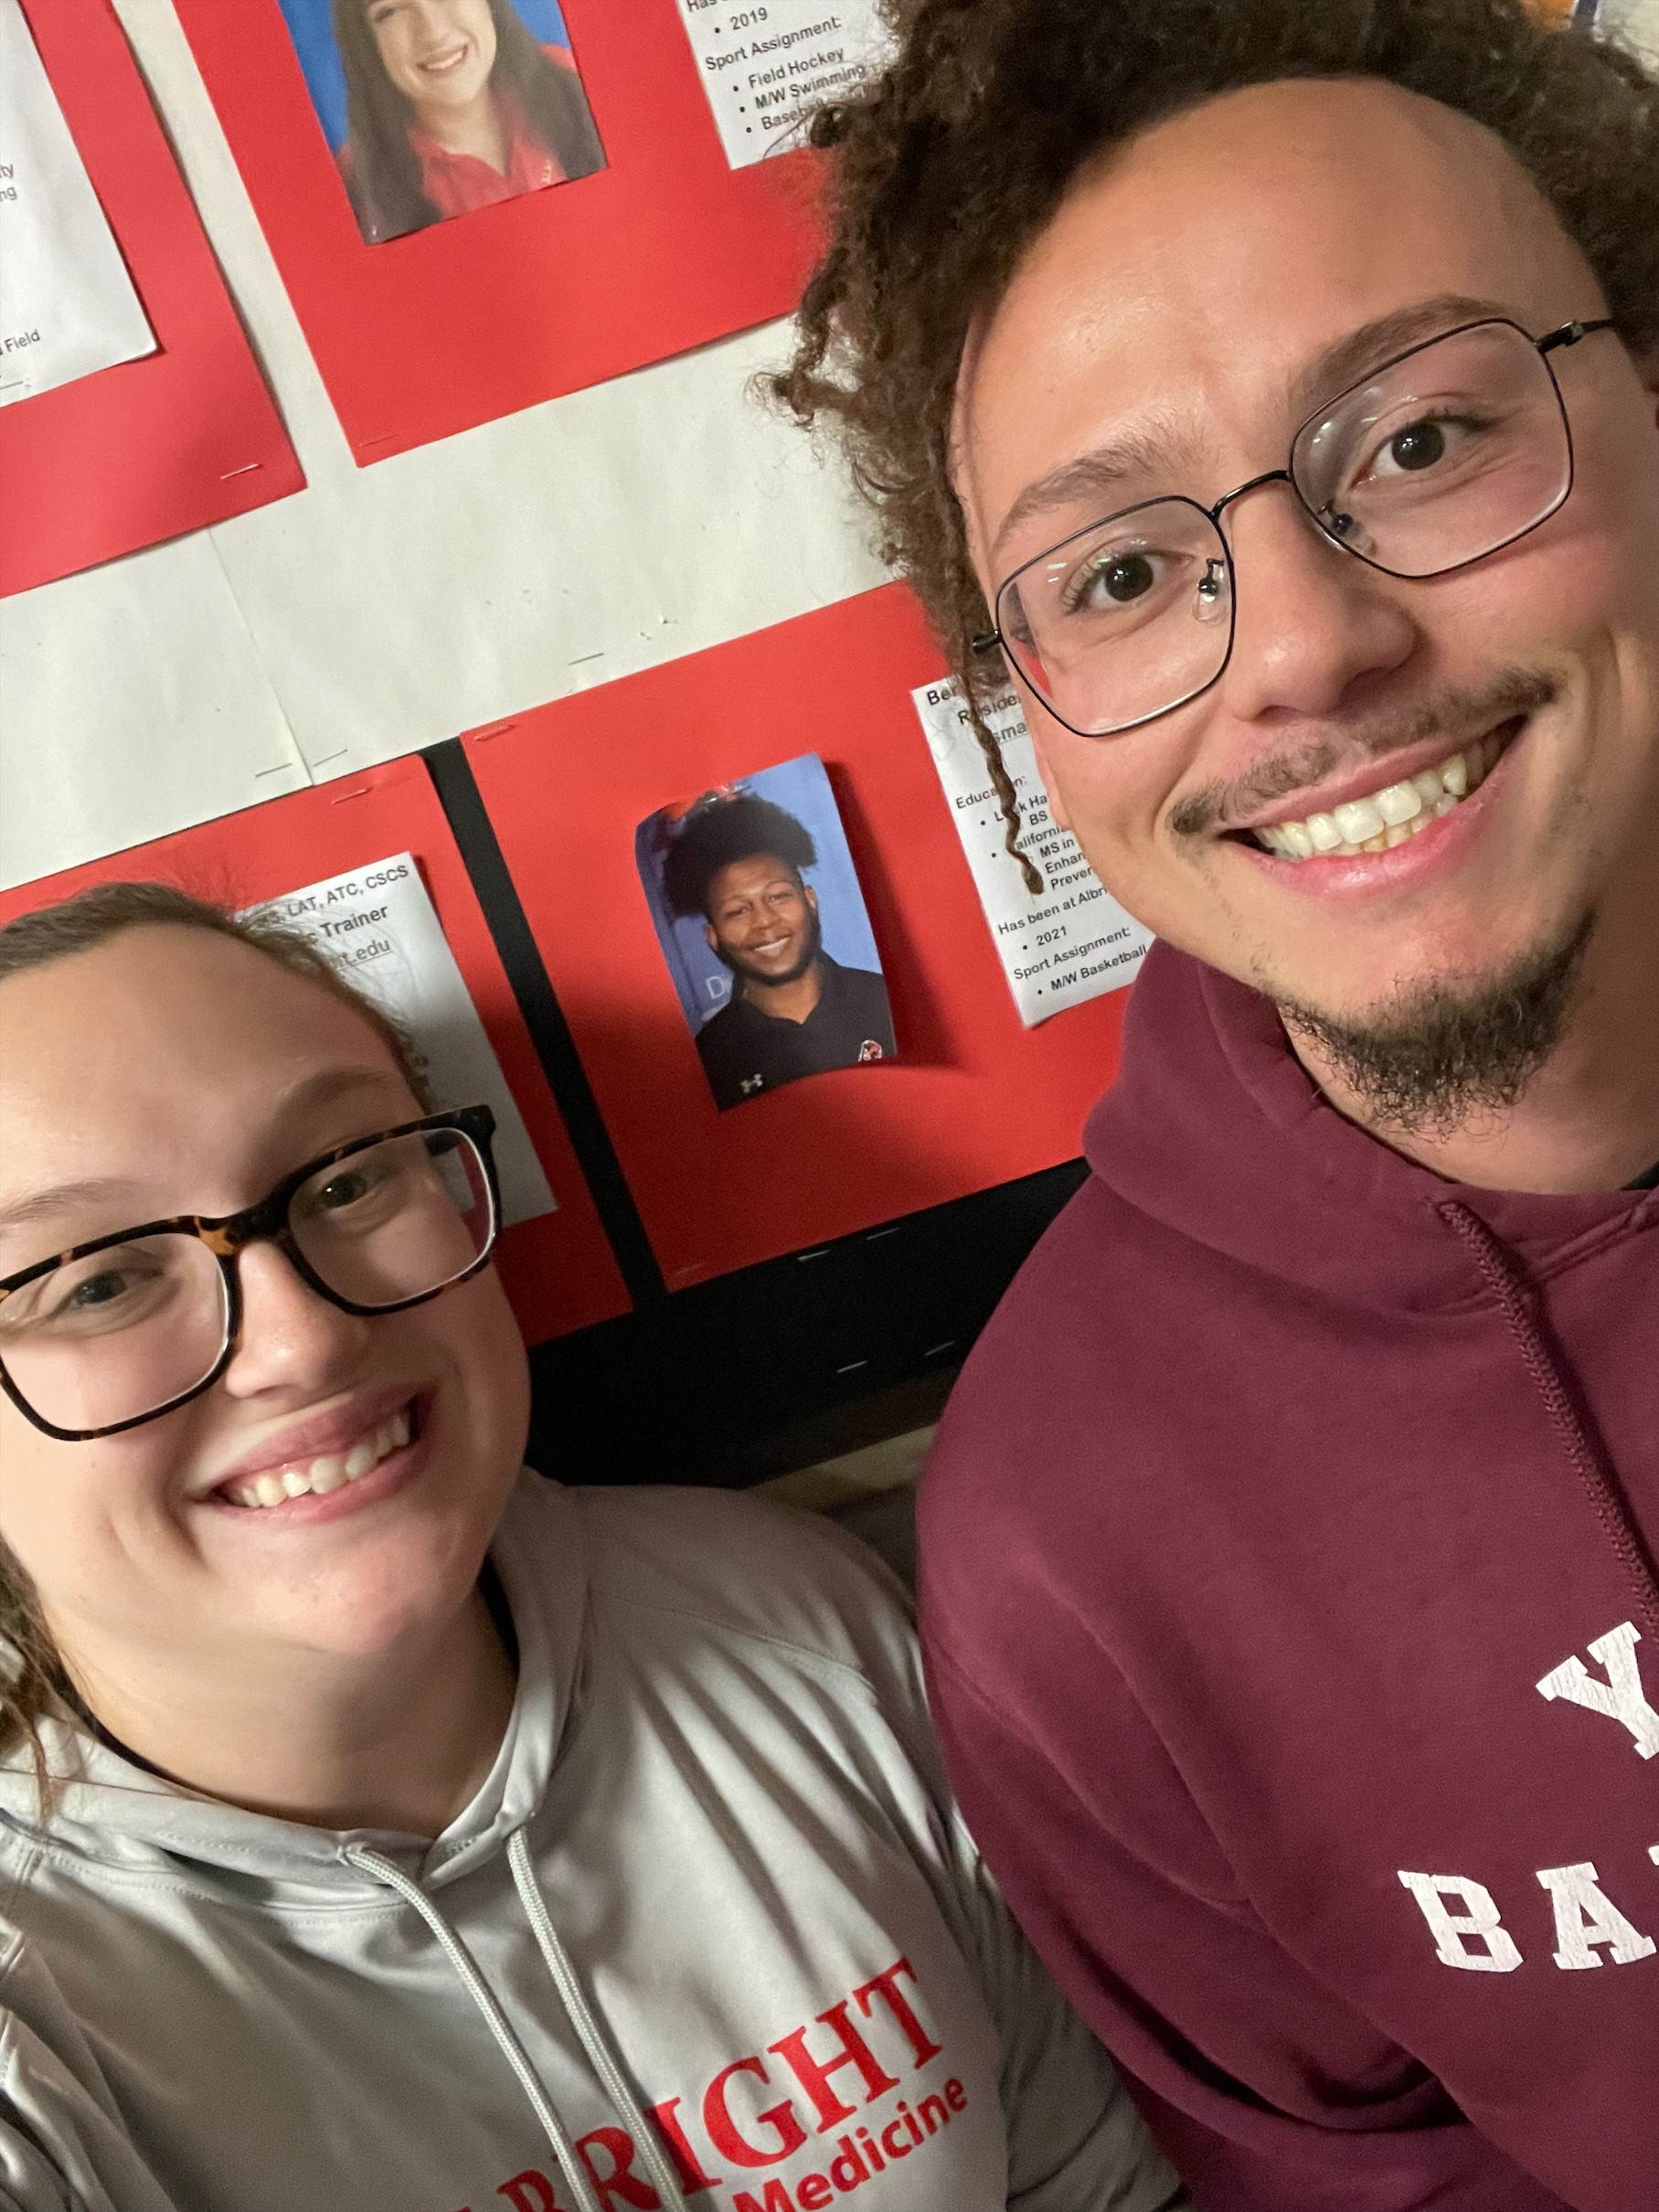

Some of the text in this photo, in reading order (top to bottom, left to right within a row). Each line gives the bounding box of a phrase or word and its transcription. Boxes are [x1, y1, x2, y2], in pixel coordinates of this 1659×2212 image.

[730, 7, 768, 30] 2019
[706, 16, 842, 70] Sport Assignment:
[748, 48, 844, 89] Field Hockey
[755, 64, 866, 109] M/W Swimming
[5, 327, 40, 352] Field
[1029, 810, 1048, 825] BS
[1039, 838, 1075, 858] MS in
[326, 883, 364, 905] ATC,
[365, 865, 409, 889] CSCS
[320, 905, 388, 938] Trainer
[998, 919, 1026, 935] Has
[1027, 906, 1060, 925] been
[1063, 896, 1078, 910] at
[1014, 926, 1132, 981] Sport Assignment:
[1036, 925, 1068, 947] 2021
[1051, 944, 1147, 991] M/W Basketball
[1397, 1845, 1659, 1973] BA
[733, 2077, 968, 2212] Medicine
